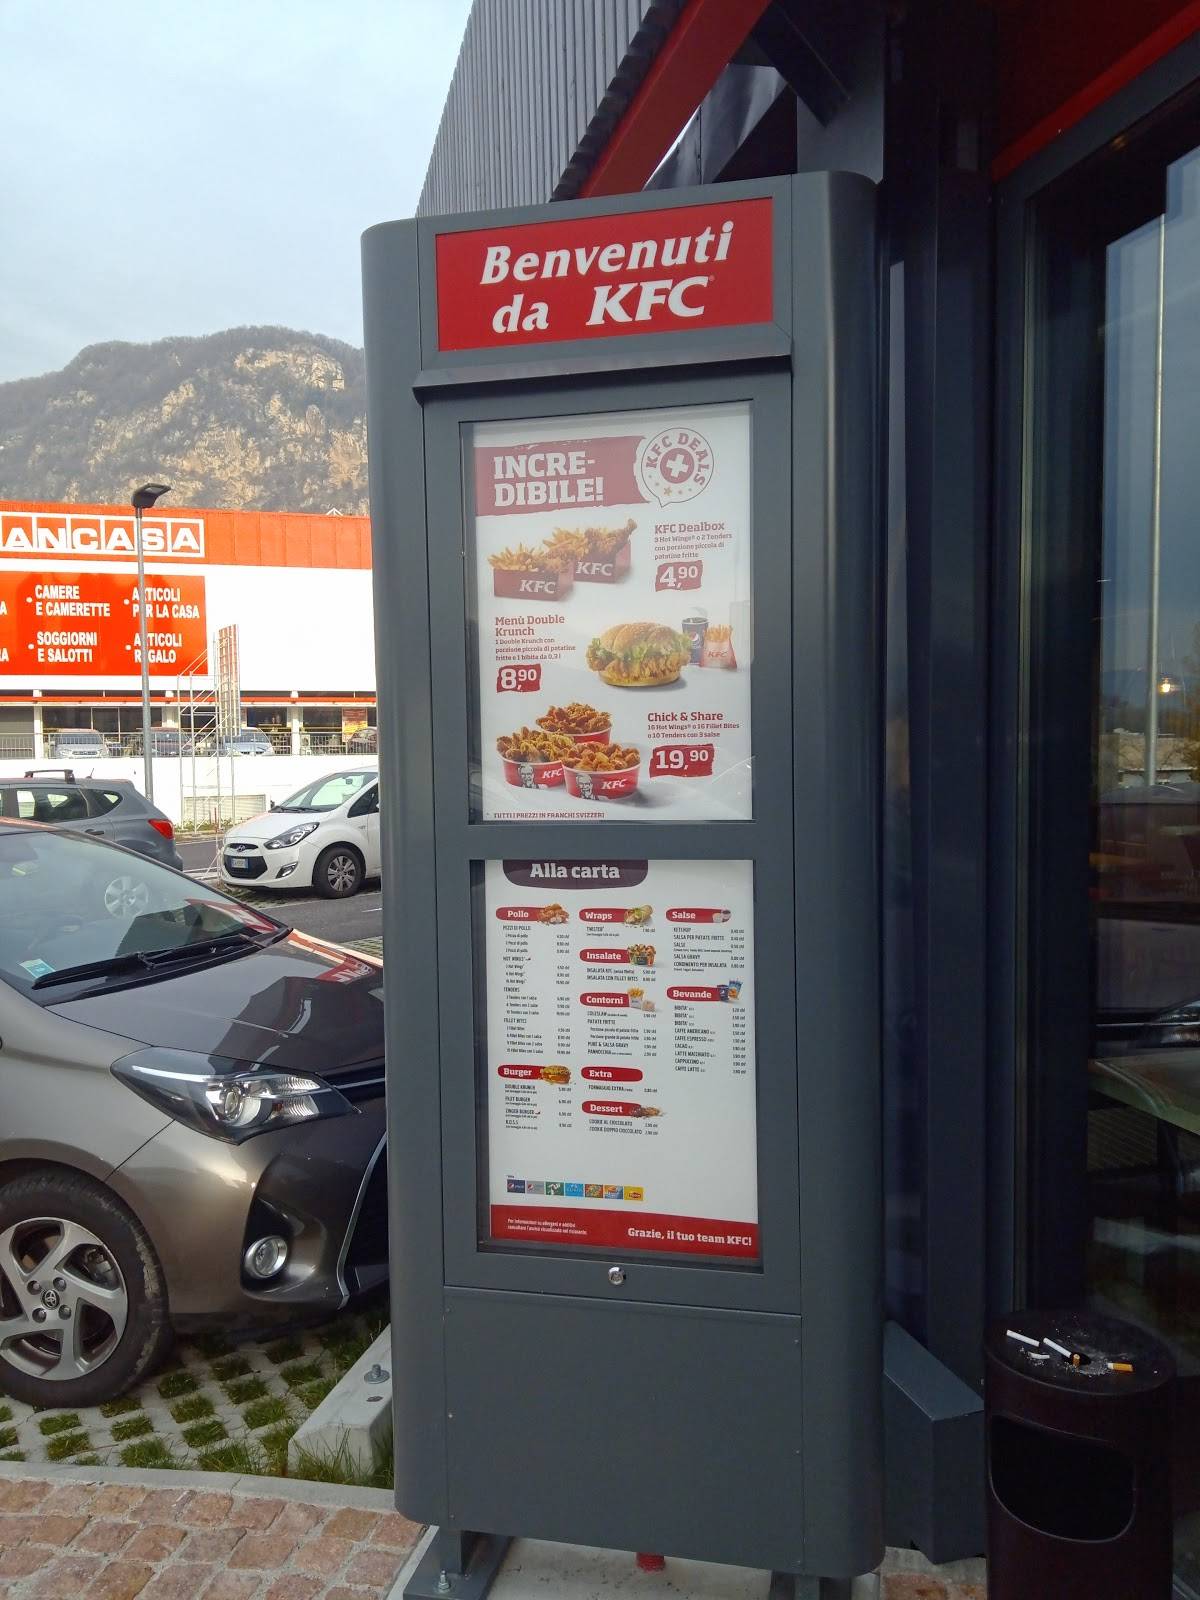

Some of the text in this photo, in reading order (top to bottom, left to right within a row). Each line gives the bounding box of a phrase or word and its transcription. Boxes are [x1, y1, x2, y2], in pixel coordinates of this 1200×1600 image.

[480, 220, 734, 284] Benvenuti
[492, 275, 709, 334] da KFC
[494, 451, 596, 479] INCRE-
[646, 433, 709, 485] KFC DEALS
[494, 477, 604, 507] DIBILE!
[655, 521, 725, 534] KFC Dealbox
[5, 527, 201, 551] ANCASA
[659, 535, 671, 543] Hot
[667, 543, 695, 552] porzione
[695, 541, 717, 550] piccola
[654, 551, 699, 561] patatine fritte
[575, 561, 613, 576] KFC
[35, 584, 80, 600] CAMERE
[520, 579, 556, 594] KFC
[132, 587, 181, 602] ATICOLI
[35, 602, 110, 617] E CAMERETTE
[133, 604, 200, 619] PR LA CASA
[495, 613, 565, 626] Menù Double
[37, 631, 97, 645] SOGGIORNI
[495, 627, 535, 636] Krunch
[133, 633, 182, 647] ATICOLI
[38, 649, 93, 663] E SALOTTI
[134, 649, 177, 663] RGALO
[707, 650, 728, 658] KFC
[647, 711, 724, 721] Chick & Share
[661, 731, 686, 739] Tenders
[542, 767, 562, 779] KFC
[601, 778, 627, 789] KFC
[530, 862, 620, 879] Alla carta
[507, 910, 529, 918] Pollo
[585, 911, 613, 920] Wraps
[672, 911, 696, 920] Salse
[586, 951, 622, 961] Insalate
[586, 995, 624, 1005] Contorni
[672, 989, 712, 999] Bevande
[503, 1067, 533, 1077] Burger
[589, 1069, 613, 1078] Extra
[590, 1103, 623, 1113] Dessert
[628, 1227, 752, 1247] Grazie, il tuo team KFC!
